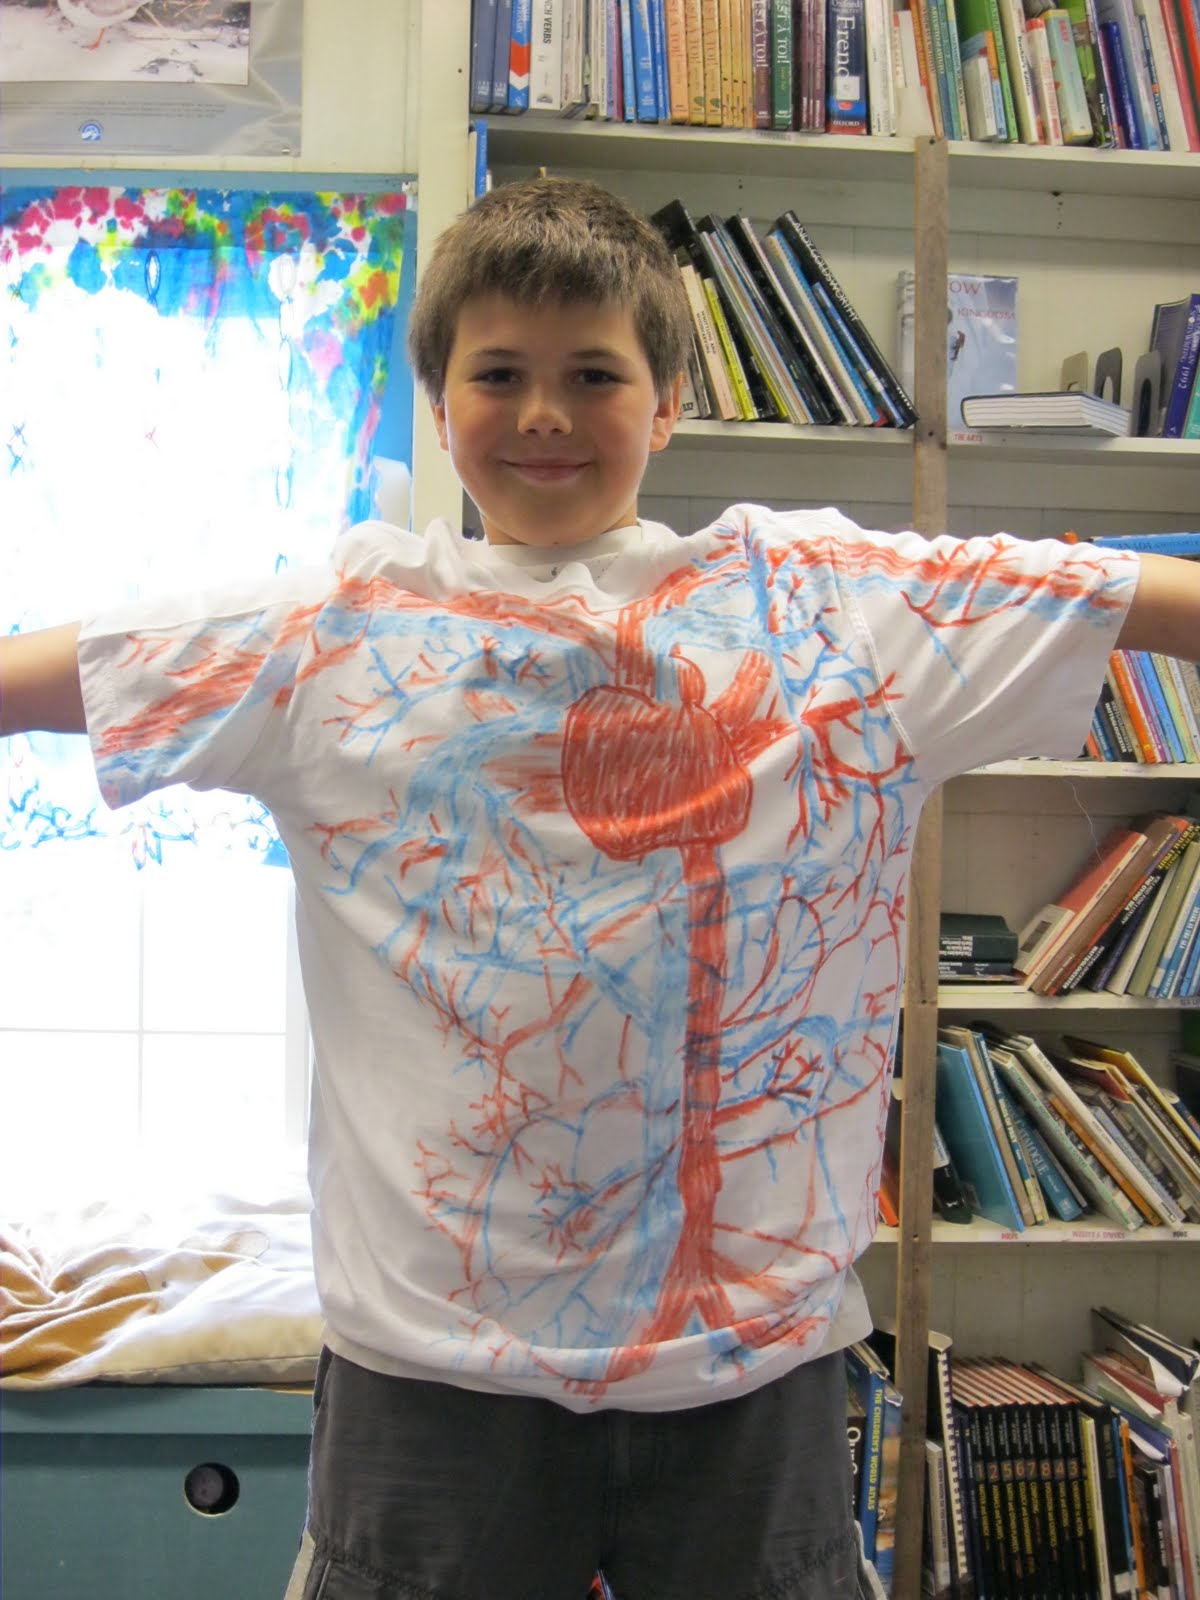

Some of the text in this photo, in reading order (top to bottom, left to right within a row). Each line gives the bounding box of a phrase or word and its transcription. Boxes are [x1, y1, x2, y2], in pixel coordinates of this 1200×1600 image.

[543, 17, 551, 44] VERBS
[755, 40, 767, 66] TOI!
[776, 37, 789, 62] TOI!
[836, 16, 855, 77] Frenc
[832, 119, 860, 127] OXFORD
[792, 220, 859, 322] ANDY GOLDSWORTHY
[949, 281, 981, 295] OW
[699, 310, 713, 341] WHITTLING
[1177, 365, 1190, 389] 1992
[1123, 874, 1154, 912] THE DYING SEA
[1061, 945, 1098, 989] WATTS/GLOUCESTER
[1007, 1125, 1019, 1142] PREY
[1014, 1118, 1049, 1175] CATALOGUE
[867, 1388, 882, 1510] THE CHILDREN'S WORLD ATLAS
[977, 1463, 984, 1479] 1
[989, 1463, 998, 1479] 2
[1003, 1462, 1011, 1478] 5
[1016, 1461, 1024, 1477] 6
[1028, 1461, 1036, 1477] 7
[1041, 1461, 1050, 1477] 8
[1055, 1461, 1064, 1477] 4
[1069, 1461, 1078, 1477] 3
